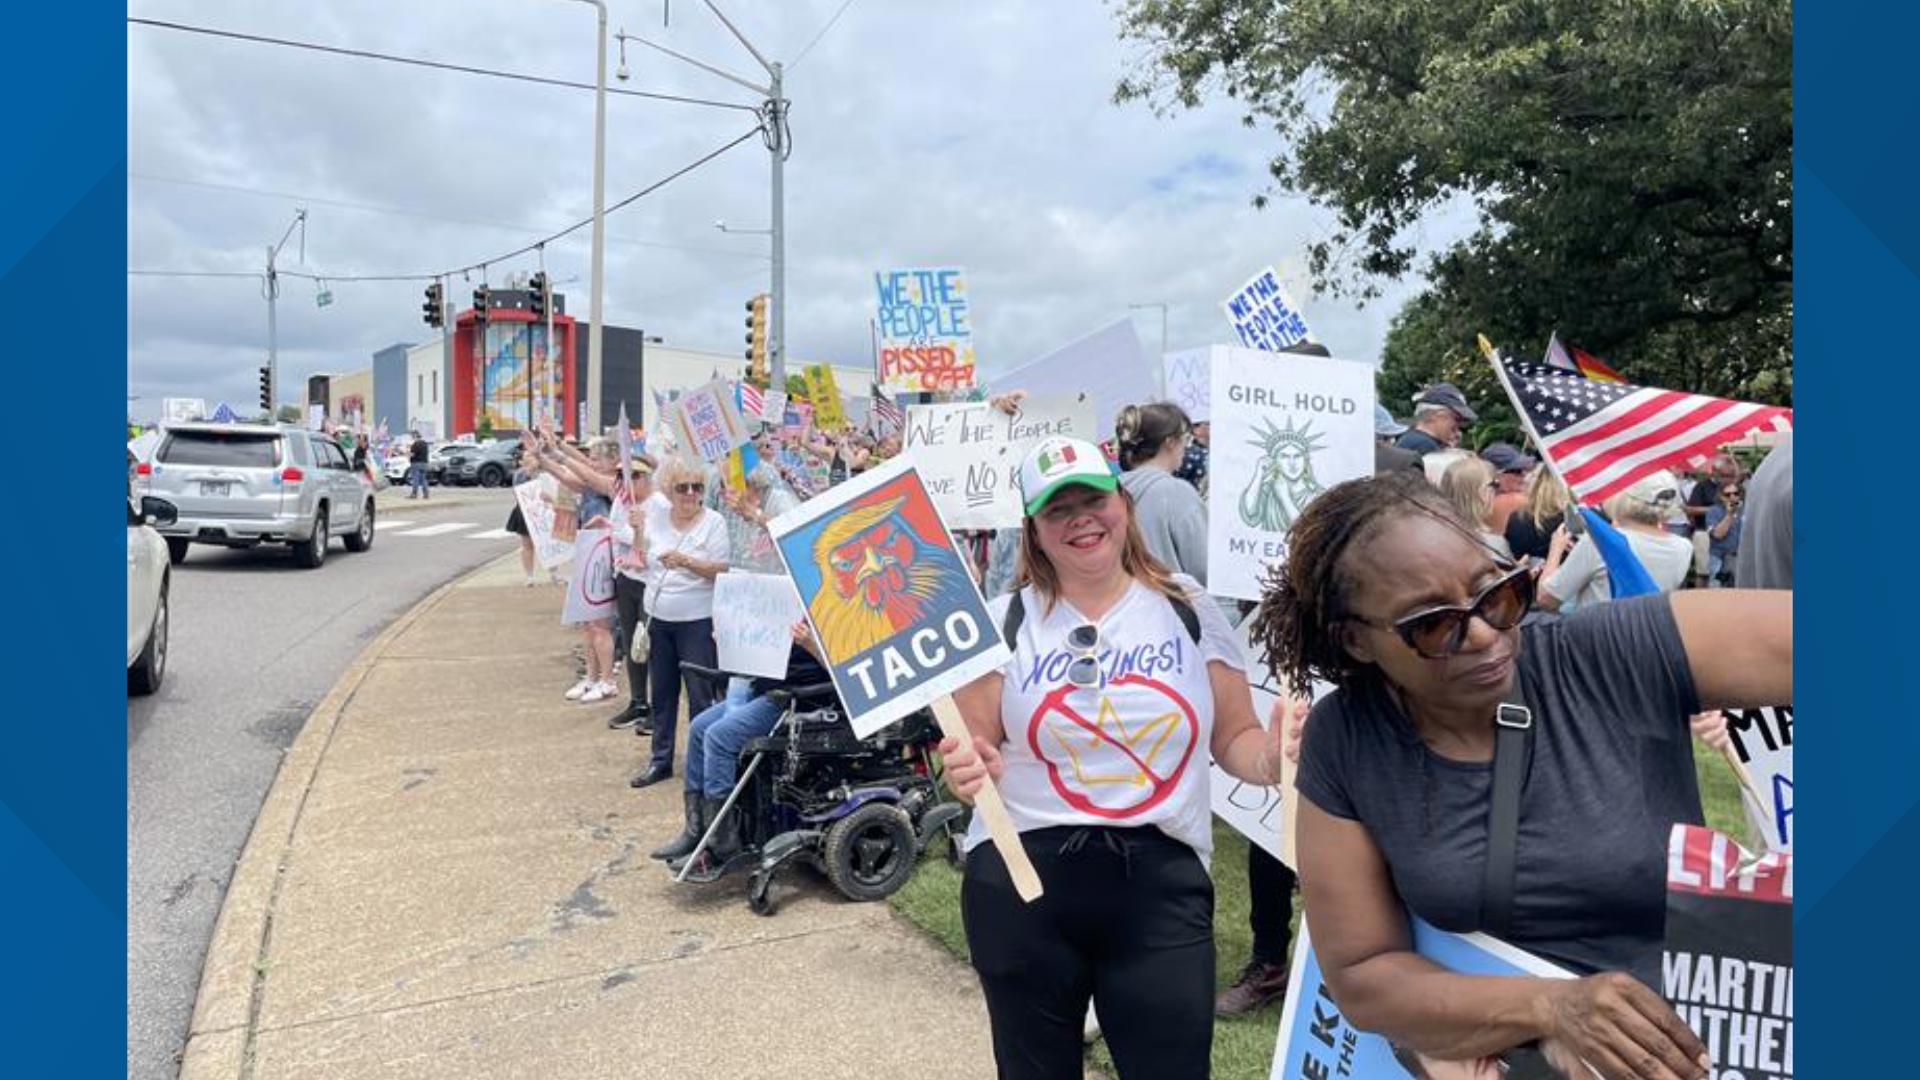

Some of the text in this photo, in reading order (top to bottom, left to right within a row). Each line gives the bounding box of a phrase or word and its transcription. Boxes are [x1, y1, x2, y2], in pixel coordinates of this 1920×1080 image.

[876, 270, 965, 304] WE THE
[1228, 272, 1279, 320] WE THE
[879, 306, 970, 338] PEOPLE
[881, 347, 955, 384] PISSED
[921, 364, 974, 389] OFF!
[1228, 385, 1356, 415] GIRL, HOLD
[966, 462, 997, 496] NO
[1229, 538, 1286, 557] MY EA
[848, 610, 980, 700] TACO
[1022, 649, 1073, 693] NO
[1337, 1028, 1358, 1077] THE
